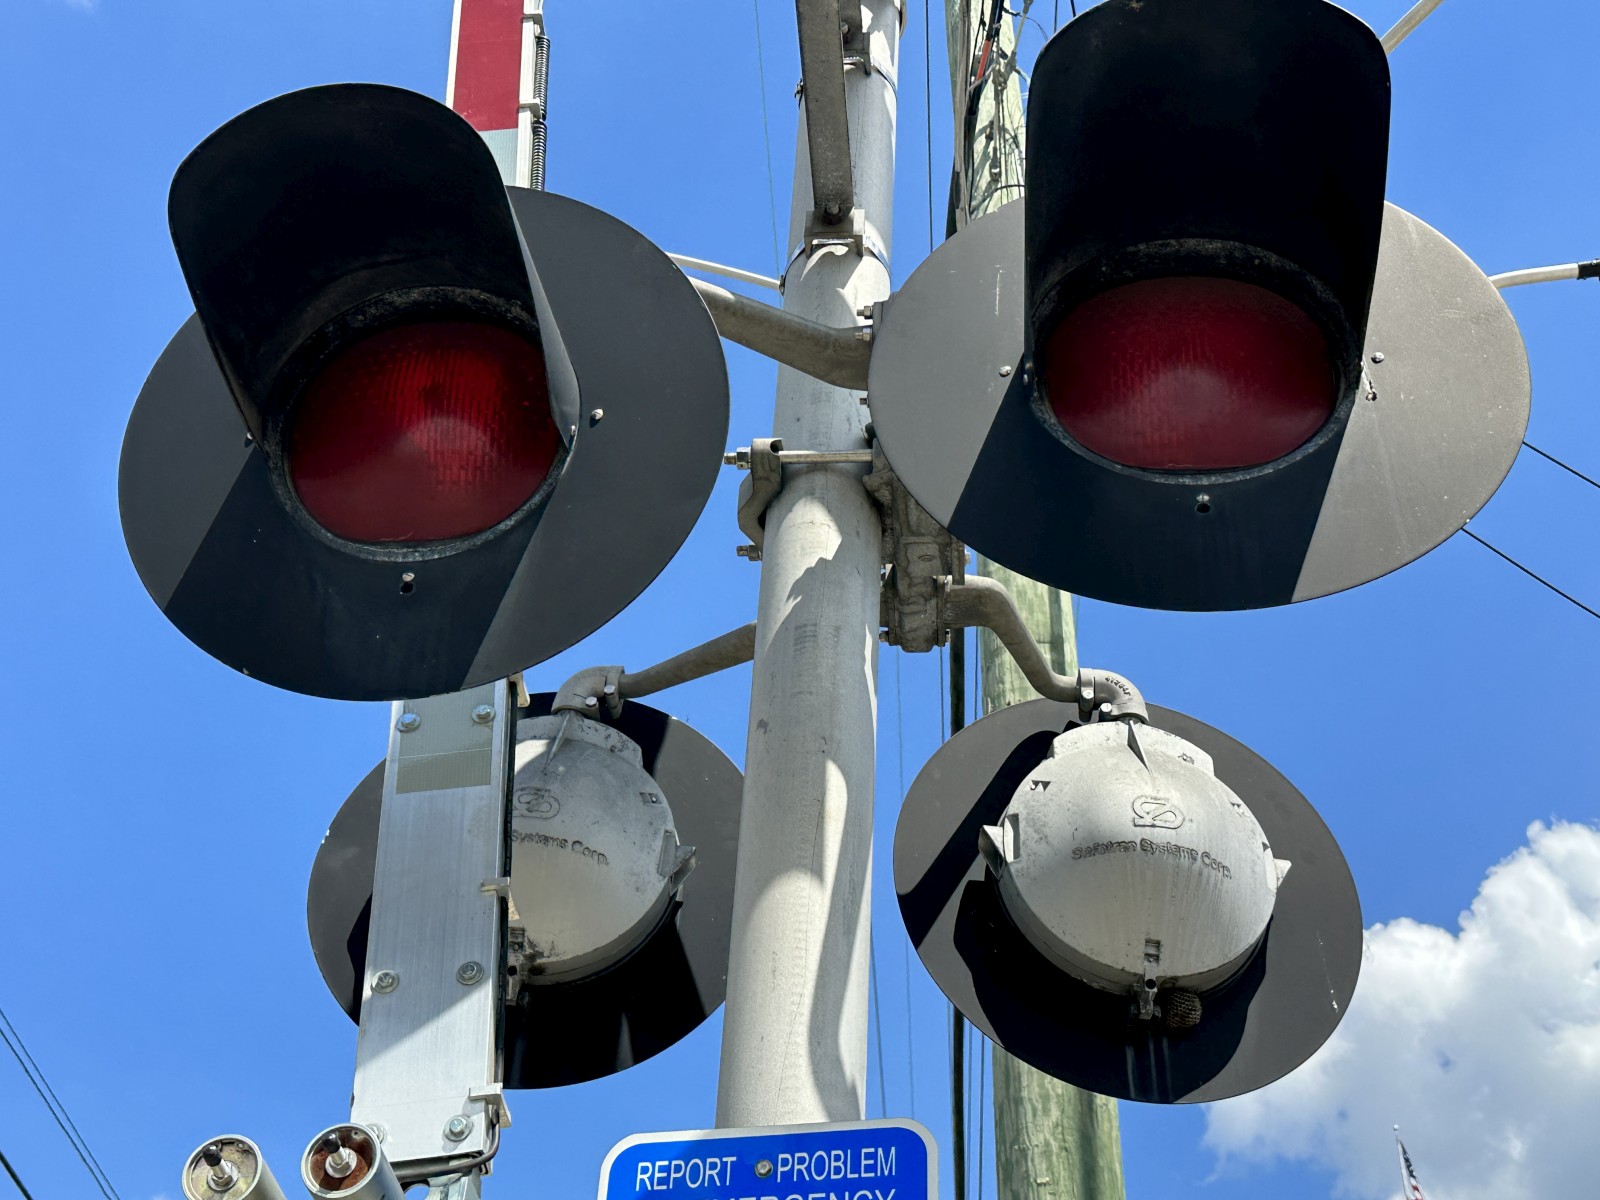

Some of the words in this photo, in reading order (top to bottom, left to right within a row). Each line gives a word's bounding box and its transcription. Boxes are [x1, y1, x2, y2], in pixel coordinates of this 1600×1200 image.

[1140, 837, 1199, 862] Systems
[635, 1156, 737, 1192] REPORT
[777, 1146, 896, 1183] PROBLEM
